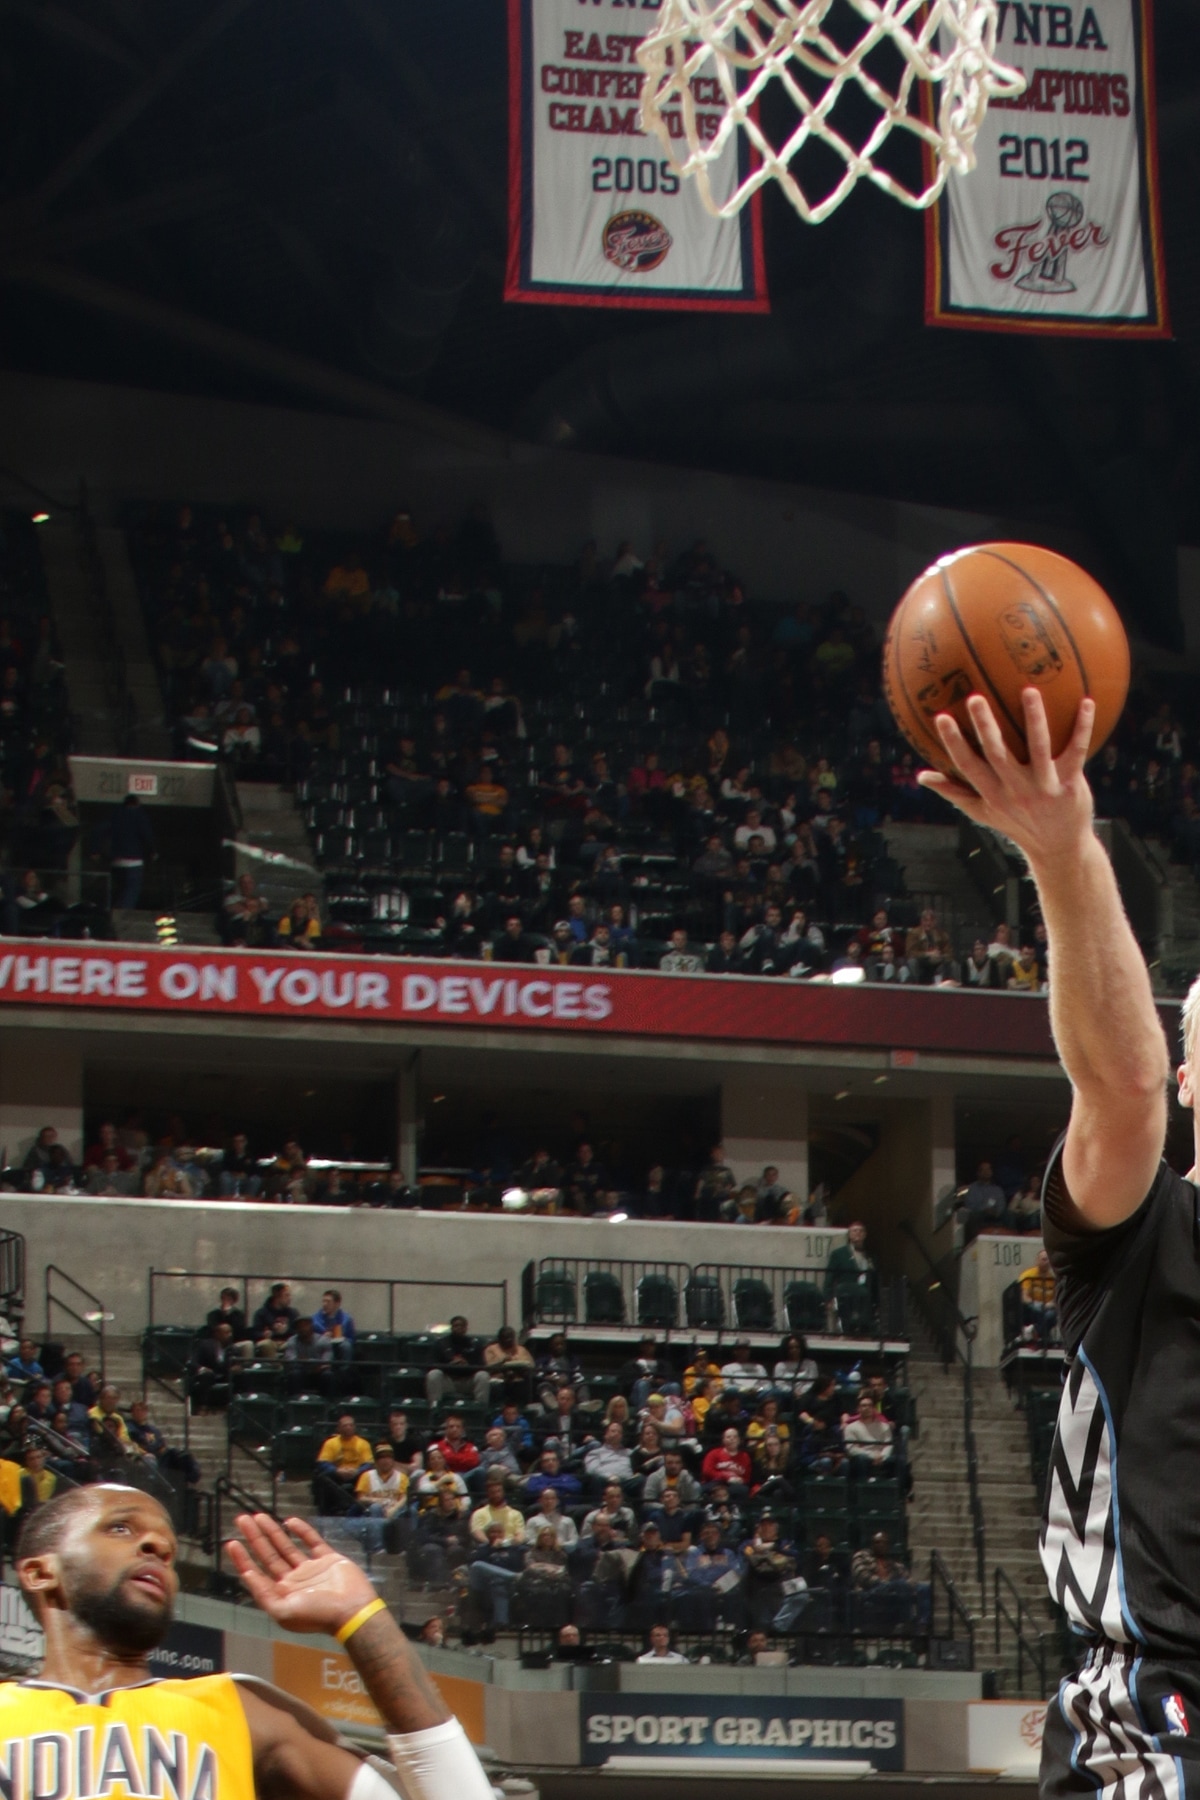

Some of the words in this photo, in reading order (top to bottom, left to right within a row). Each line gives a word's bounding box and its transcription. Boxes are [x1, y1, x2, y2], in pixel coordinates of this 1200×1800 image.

[564, 30, 706, 66] EAST
[984, 66, 1131, 117] MPIONS
[592, 156, 680, 195] 2005
[999, 134, 1089, 182] 2012
[990, 218, 1110, 280] Fever
[134, 778, 154, 791] EXIT
[0, 956, 148, 998] HERE
[159, 963, 237, 1002] ON
[249, 966, 390, 1010] YOUR
[401, 974, 613, 1021] DEVICES
[805, 1235, 833, 1258] 107
[993, 1243, 1022, 1266] 108
[587, 1714, 708, 1746] SPORT
[713, 1716, 897, 1750] GRAPHICS
